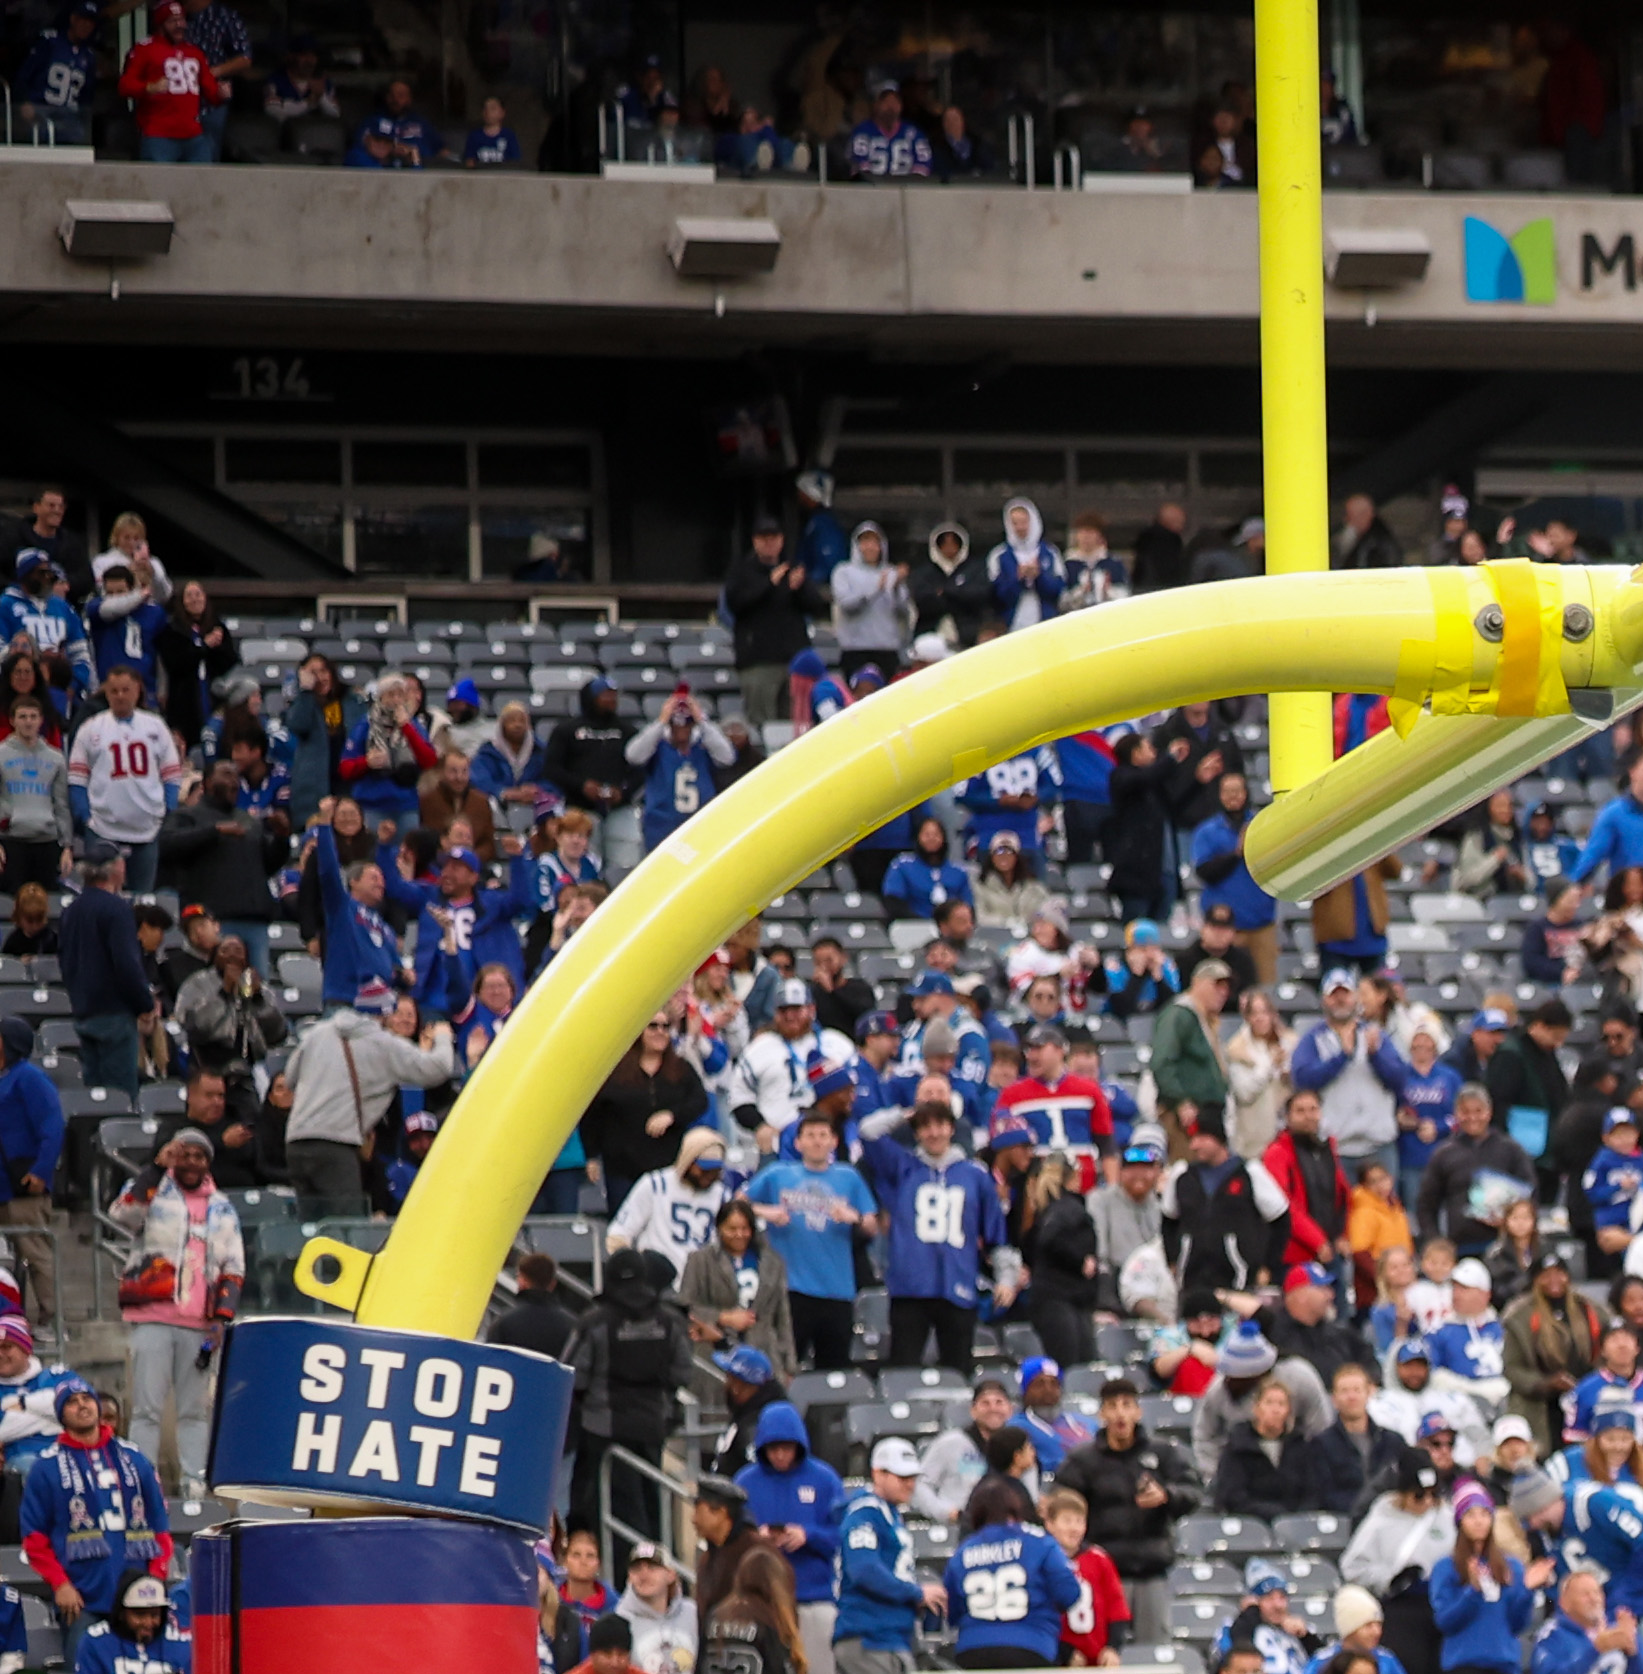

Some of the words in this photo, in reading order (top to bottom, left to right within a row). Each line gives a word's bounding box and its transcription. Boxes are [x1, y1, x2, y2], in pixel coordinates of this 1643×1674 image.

[233, 357, 310, 398] 134
[109, 742, 149, 780] 10
[671, 1203, 715, 1244] 53
[914, 1183, 967, 1249] 81
[300, 1343, 514, 1426] STOP
[292, 1411, 503, 1498] HATE
[962, 1563, 1029, 1622] 26
